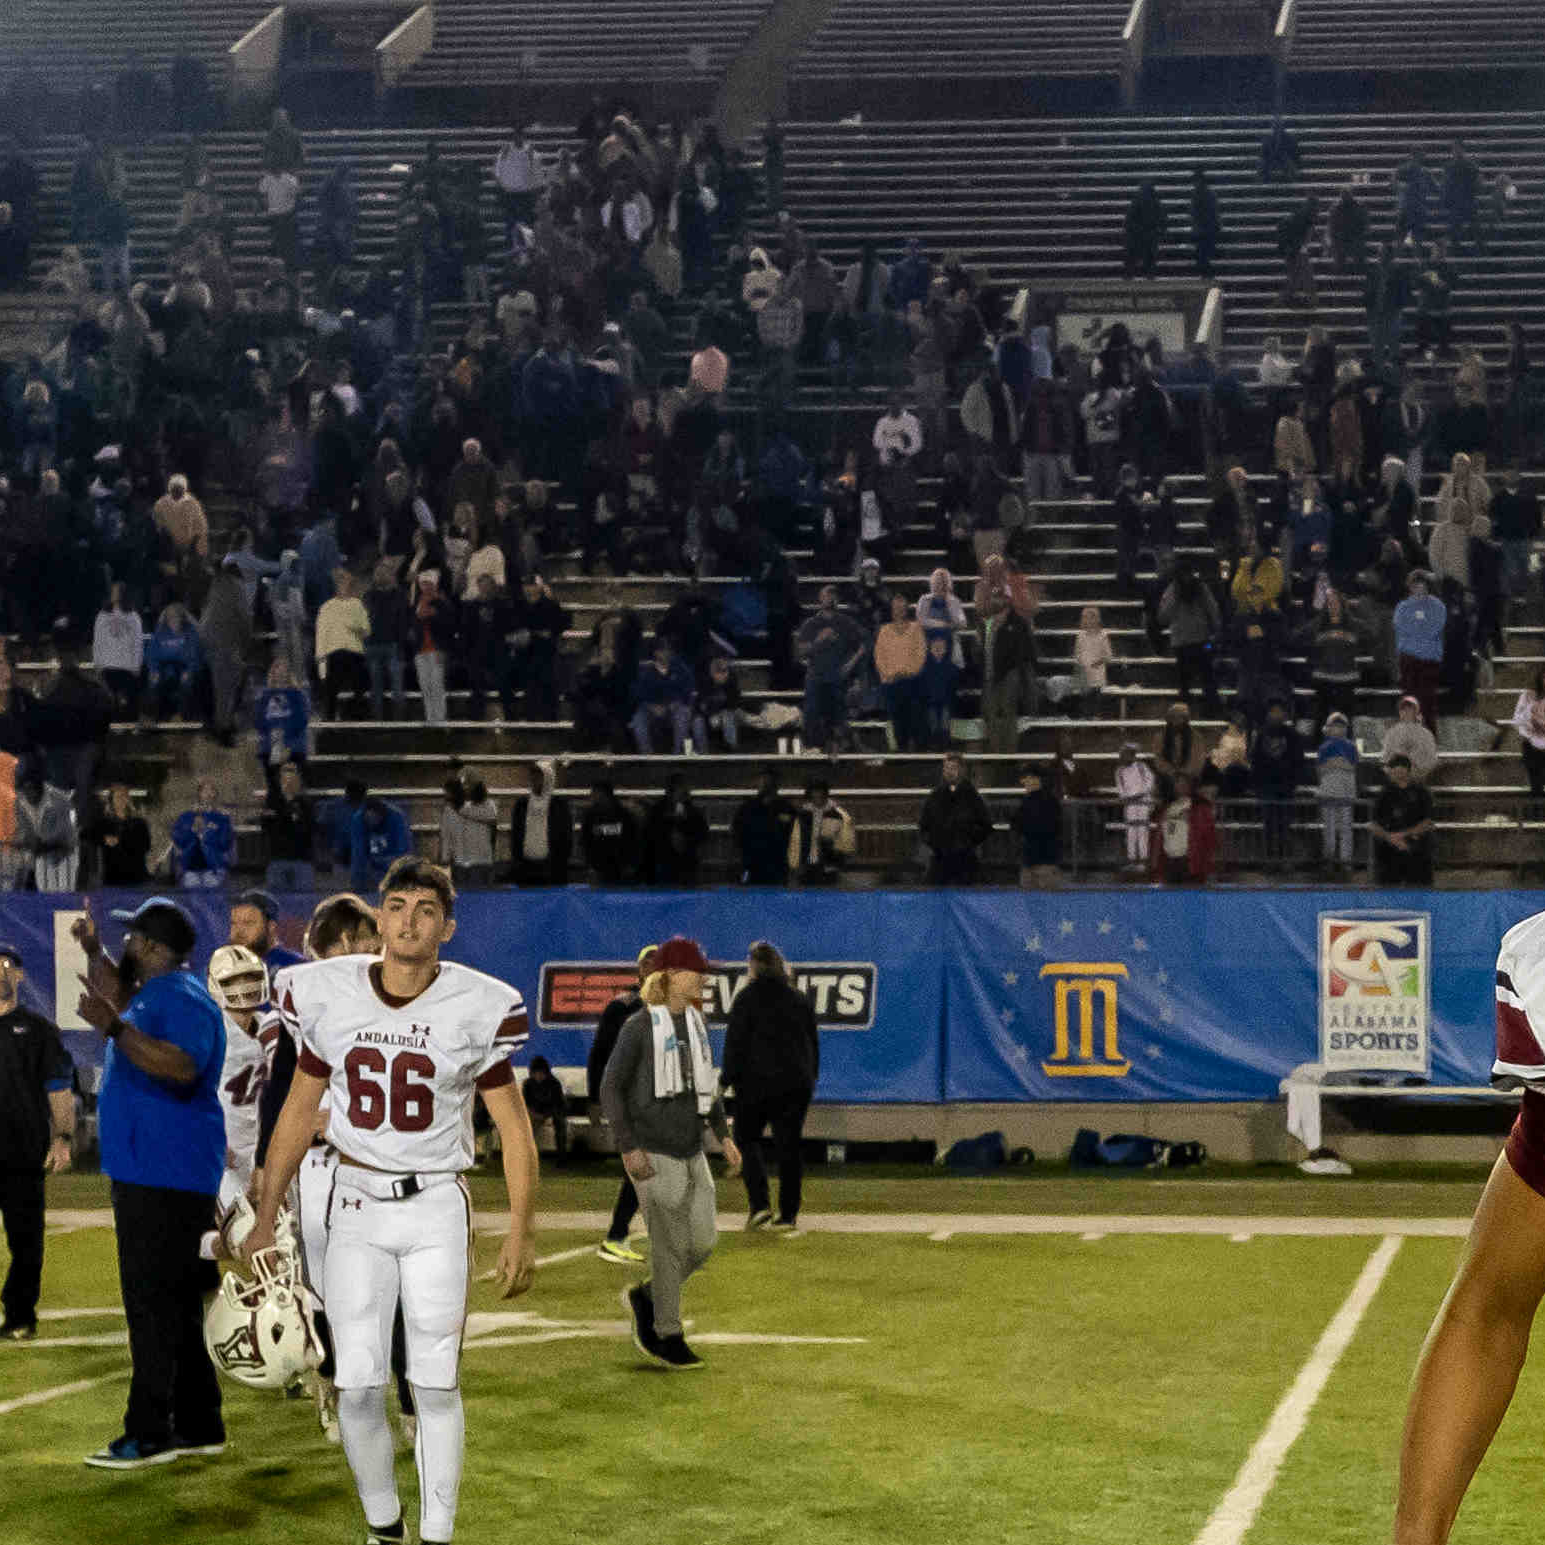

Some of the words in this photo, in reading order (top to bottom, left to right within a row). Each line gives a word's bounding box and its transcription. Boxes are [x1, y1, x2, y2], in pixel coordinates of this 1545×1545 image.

[701, 974, 865, 1016] EVTS
[1330, 1016, 1417, 1029] ALABAMA
[355, 1032, 428, 1049] ANDALUSIA
[1330, 1032, 1419, 1050] SPORTS
[344, 1046, 436, 1132] 66
